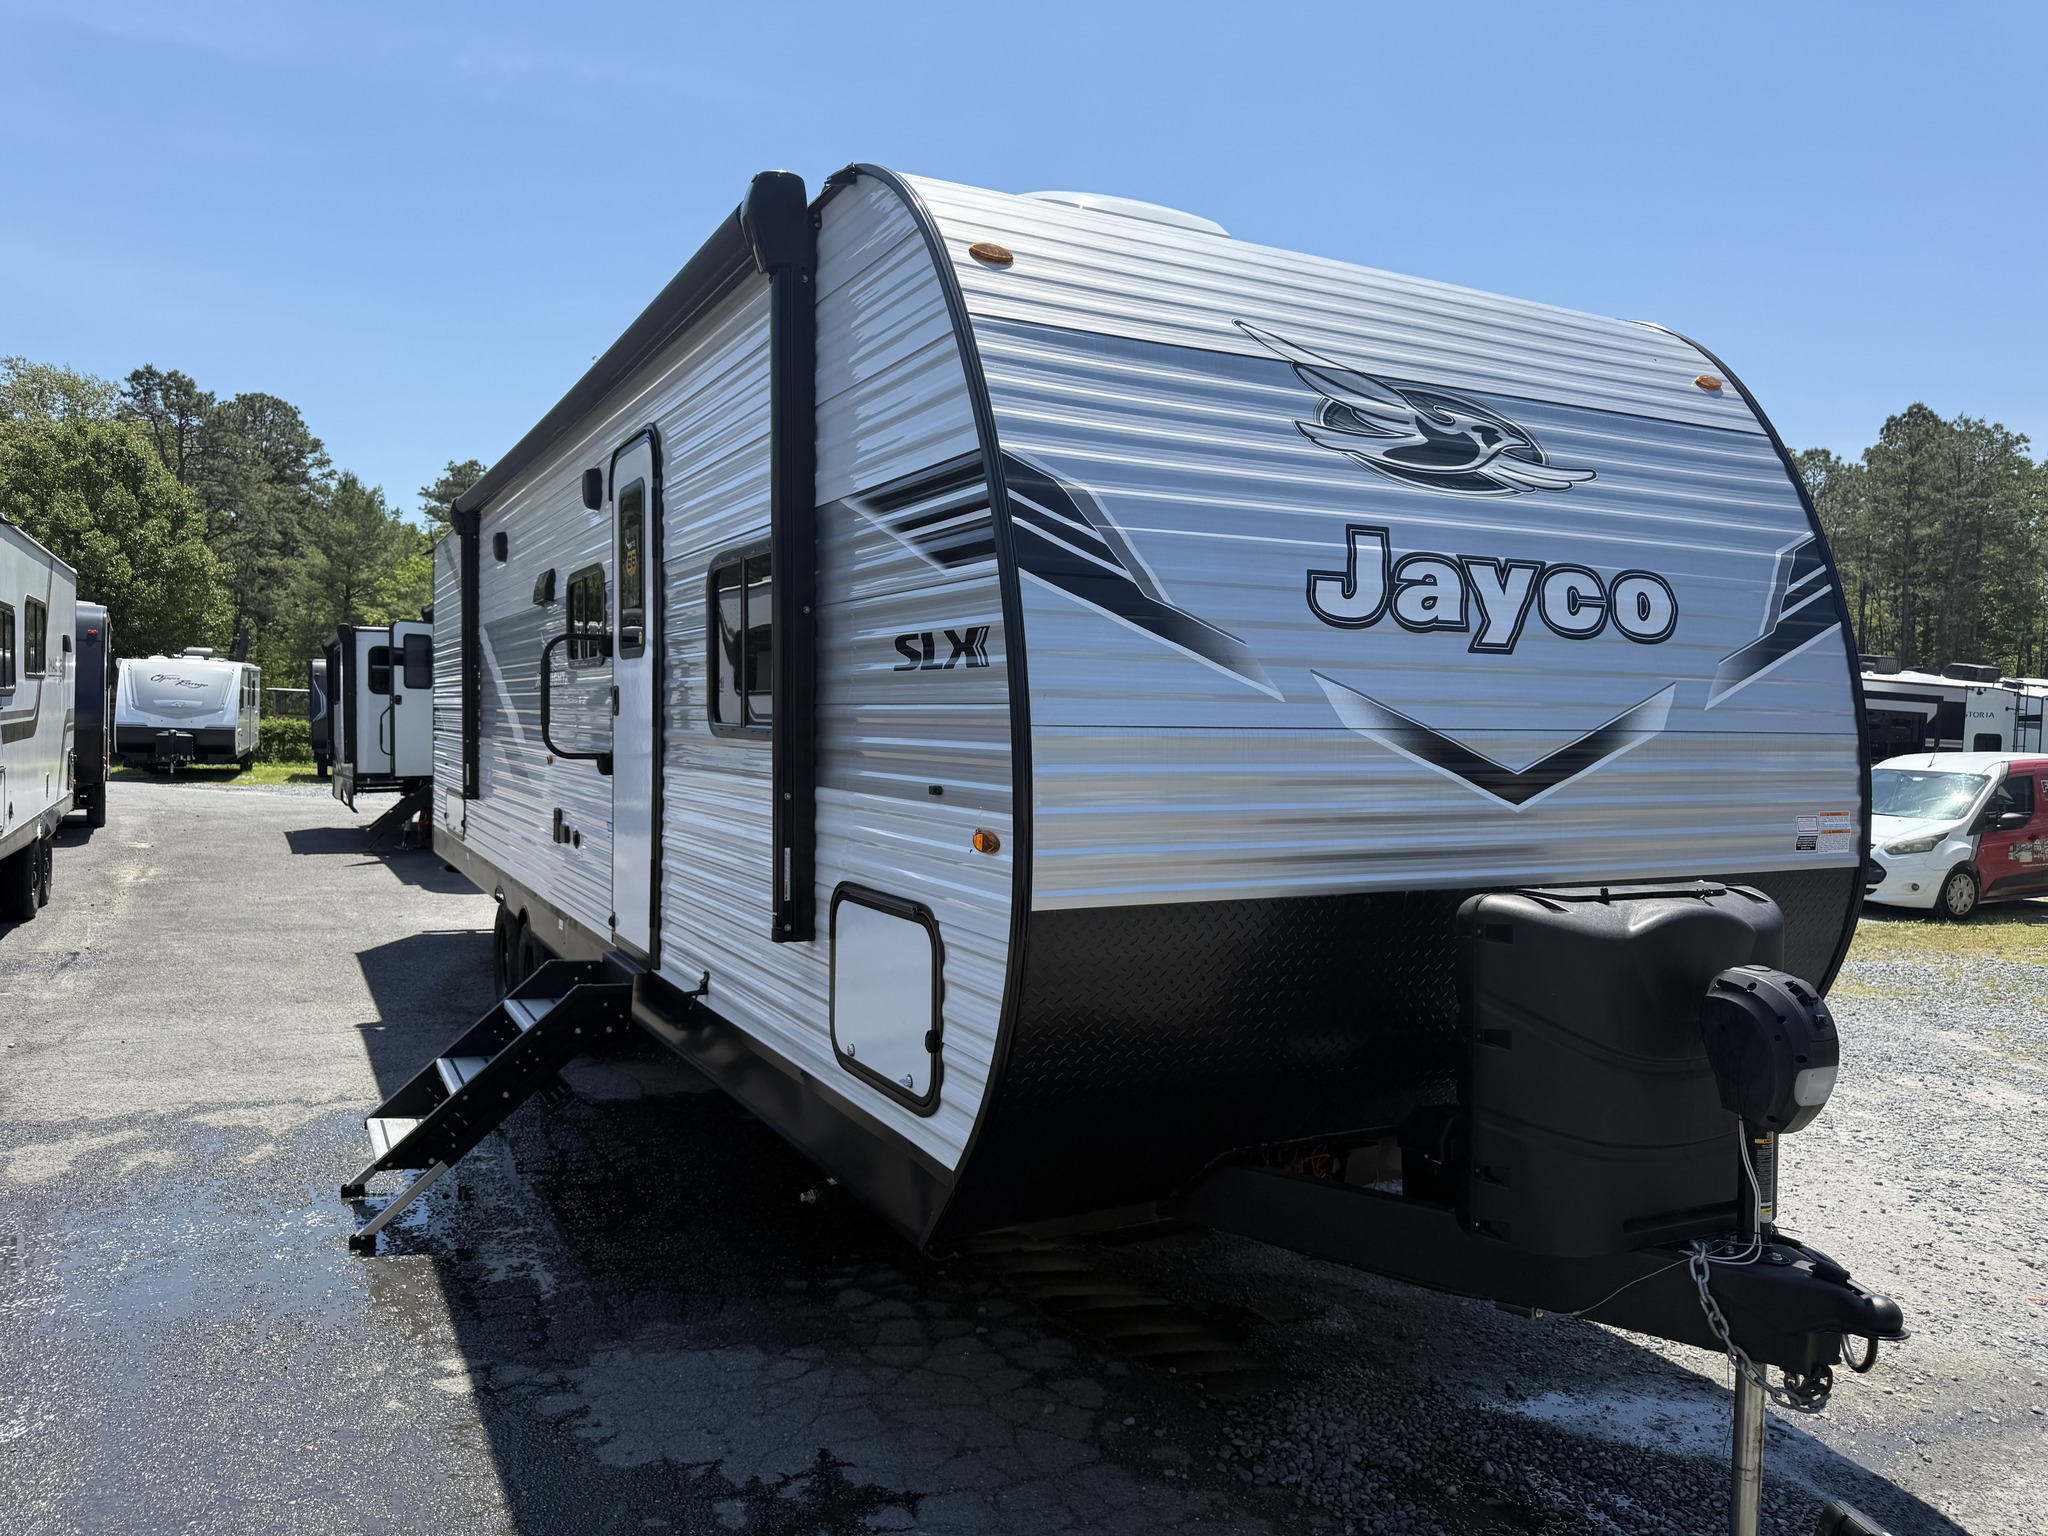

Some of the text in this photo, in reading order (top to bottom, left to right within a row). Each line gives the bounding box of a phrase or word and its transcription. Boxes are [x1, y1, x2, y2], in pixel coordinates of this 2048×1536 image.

[1306, 523, 1679, 655] Jayco
[893, 625, 990, 671] SLX
[150, 674, 209, 689] Open Range
